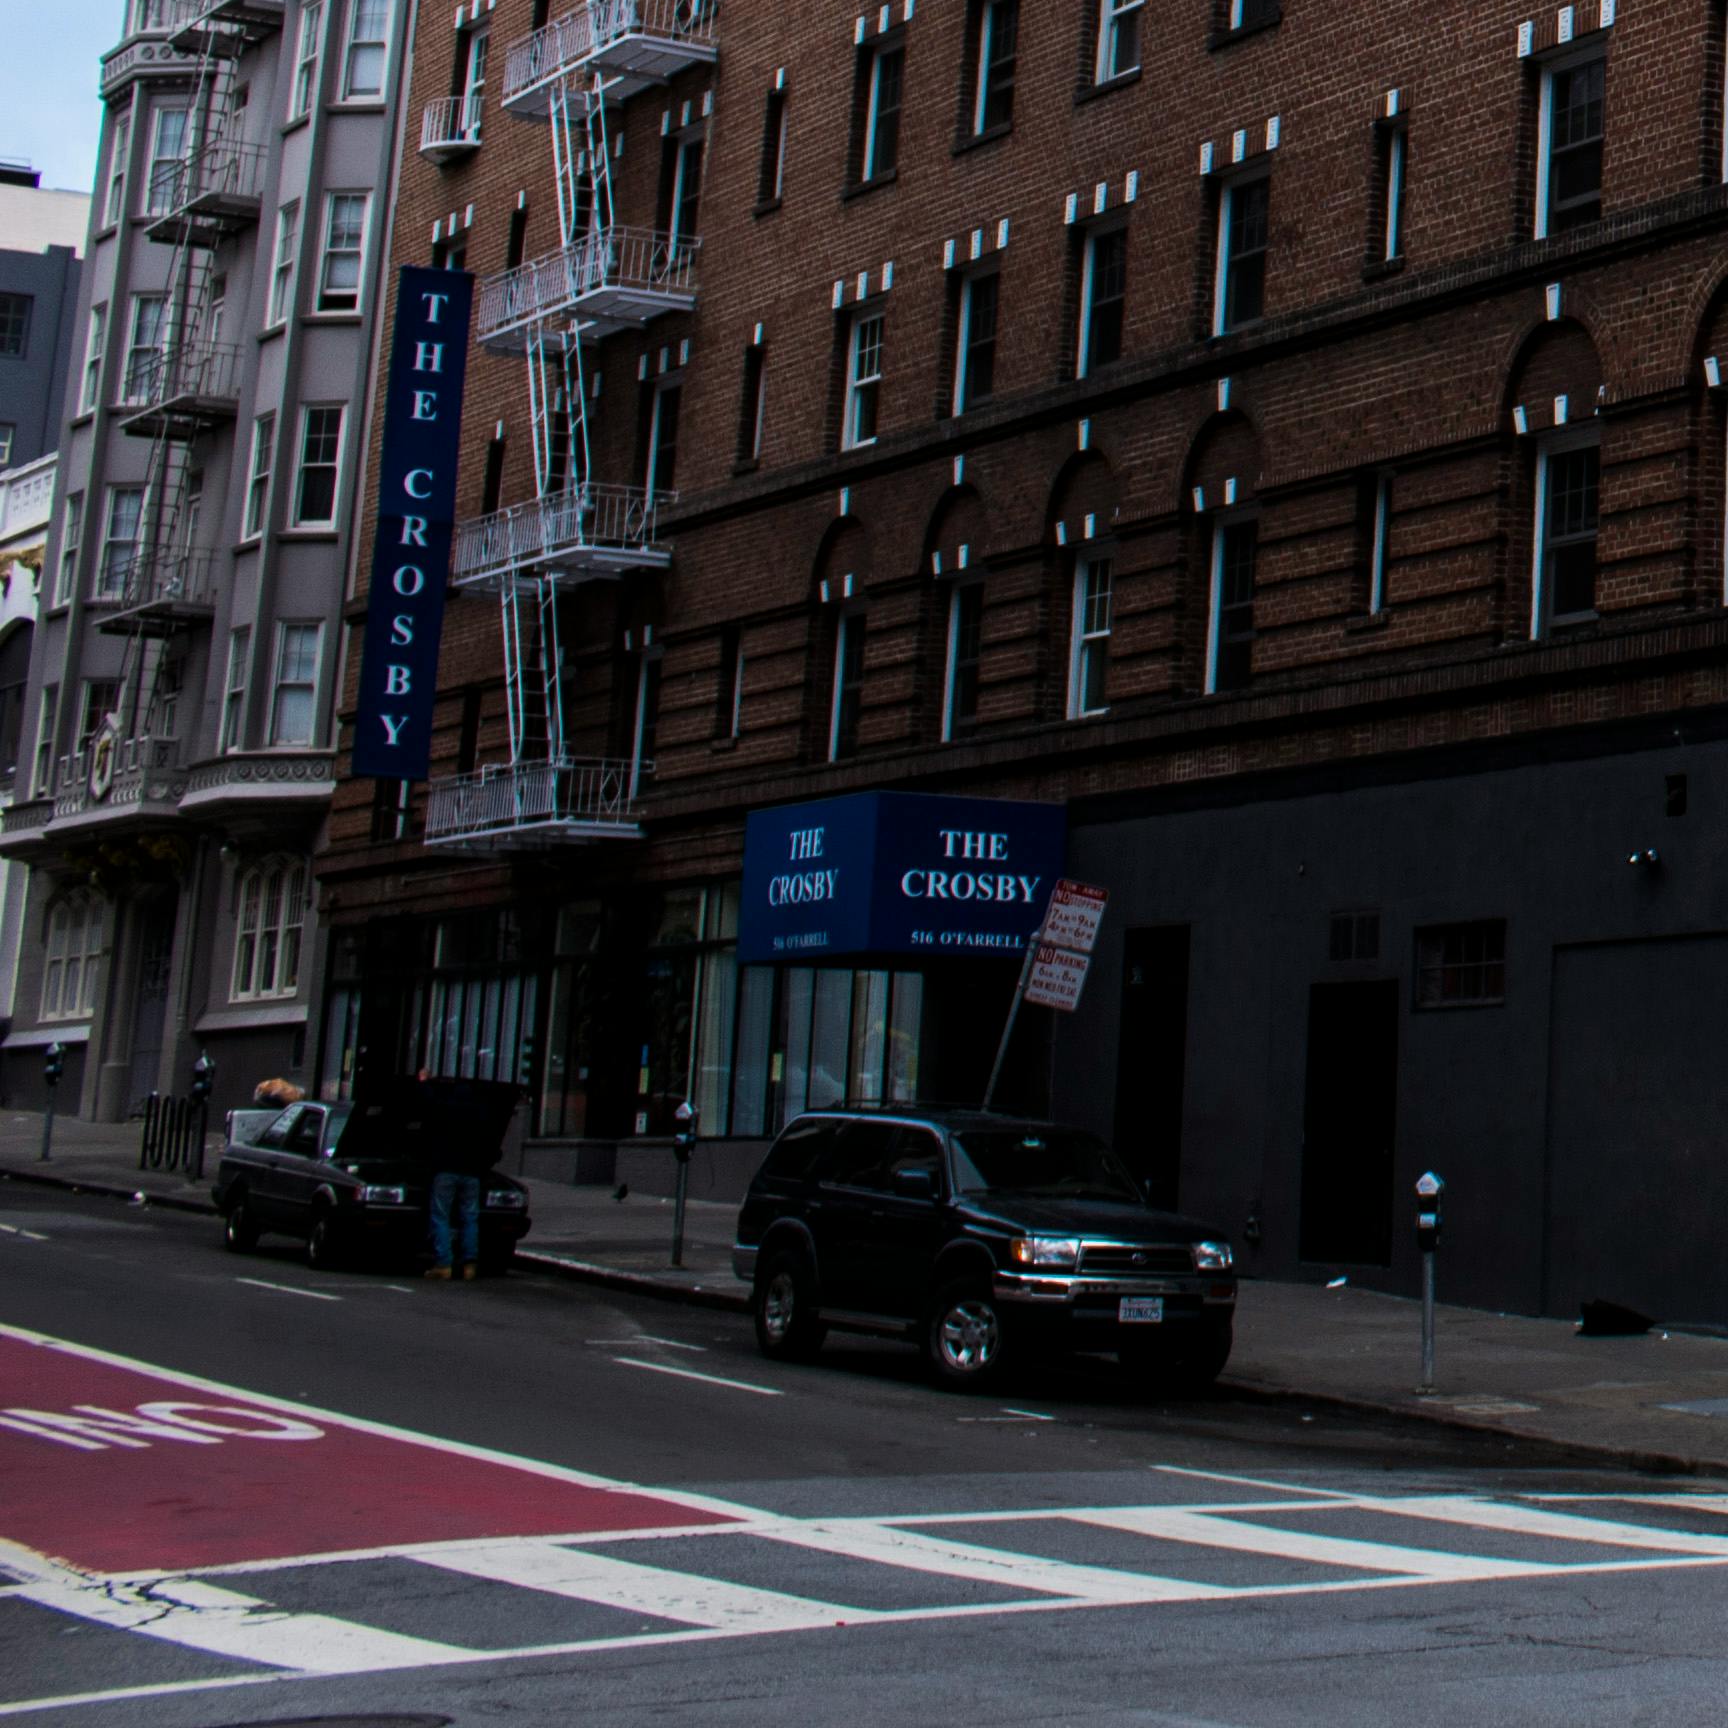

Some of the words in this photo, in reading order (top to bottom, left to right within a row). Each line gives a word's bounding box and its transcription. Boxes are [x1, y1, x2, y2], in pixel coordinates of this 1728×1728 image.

[409, 292, 449, 422] THE
[379, 469, 434, 746] CROSBY
[789, 827, 825, 861] THE
[938, 828, 1009, 861] THE
[768, 868, 839, 907] CROSBY
[900, 870, 1041, 904] CROSBY
[1055, 889, 1070, 904] NO
[1069, 894, 1104, 911] STOPPING
[911, 931, 934, 946] 516
[940, 931, 1024, 950] O'FARRELL
[1038, 946, 1054, 962] NO
[1055, 955, 1088, 970] PARKING
